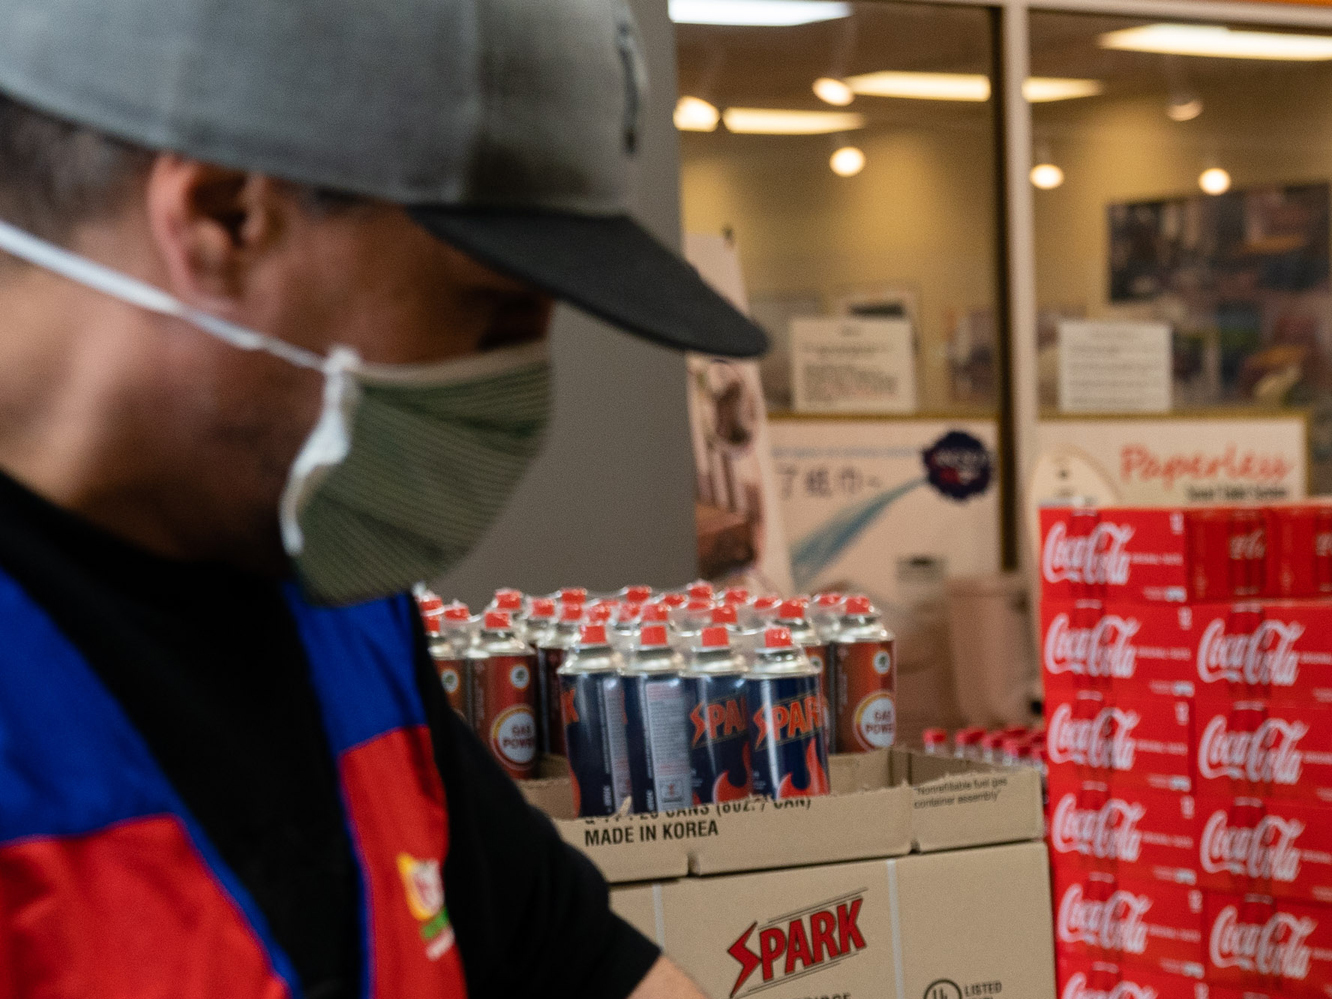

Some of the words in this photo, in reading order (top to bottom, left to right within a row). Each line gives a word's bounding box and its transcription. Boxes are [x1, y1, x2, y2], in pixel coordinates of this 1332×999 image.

[1120, 441, 1290, 490] Paperless
[584, 821, 635, 848] MADE
[637, 818, 660, 842] IN
[661, 817, 720, 841] KOREA
[727, 896, 868, 999] SPARK
[963, 981, 1003, 997] LISTED
